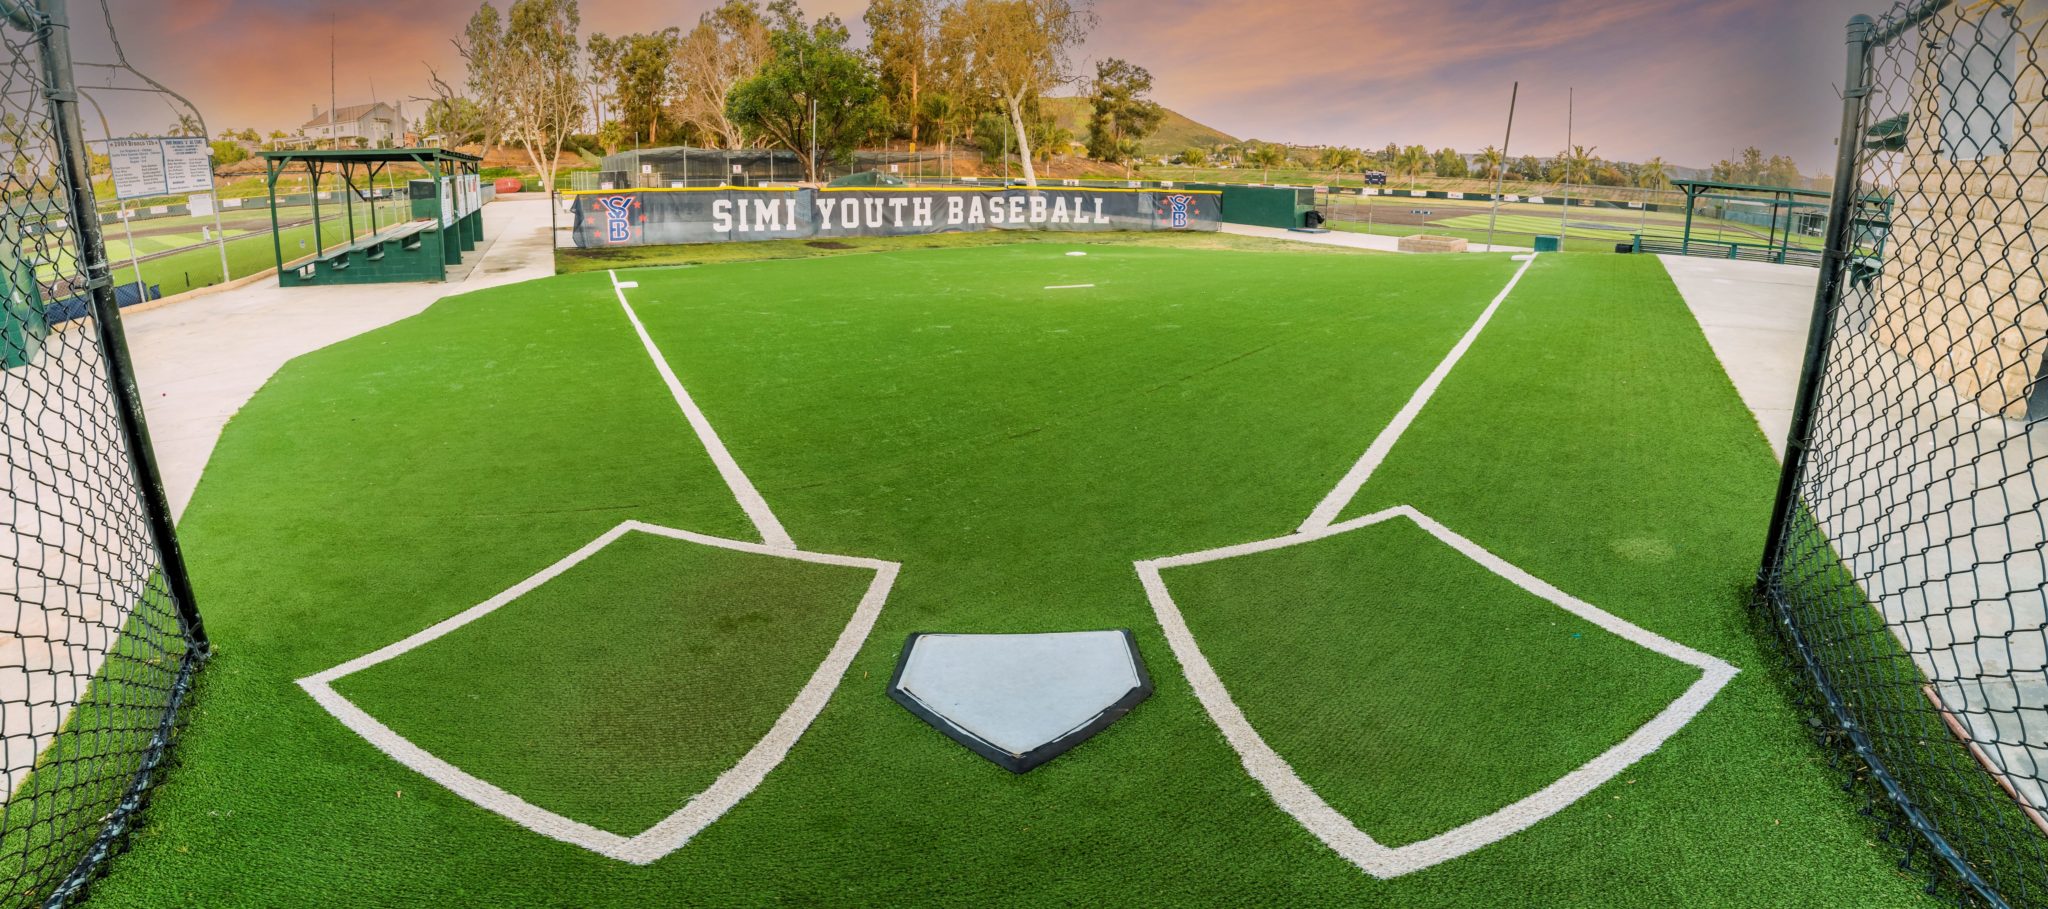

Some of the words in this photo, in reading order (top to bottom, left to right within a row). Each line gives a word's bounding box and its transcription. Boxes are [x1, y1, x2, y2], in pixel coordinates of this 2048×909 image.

[712, 199, 797, 232] SIMI
[815, 196, 933, 230] YOUTH
[947, 196, 1110, 225] BASEBALL
